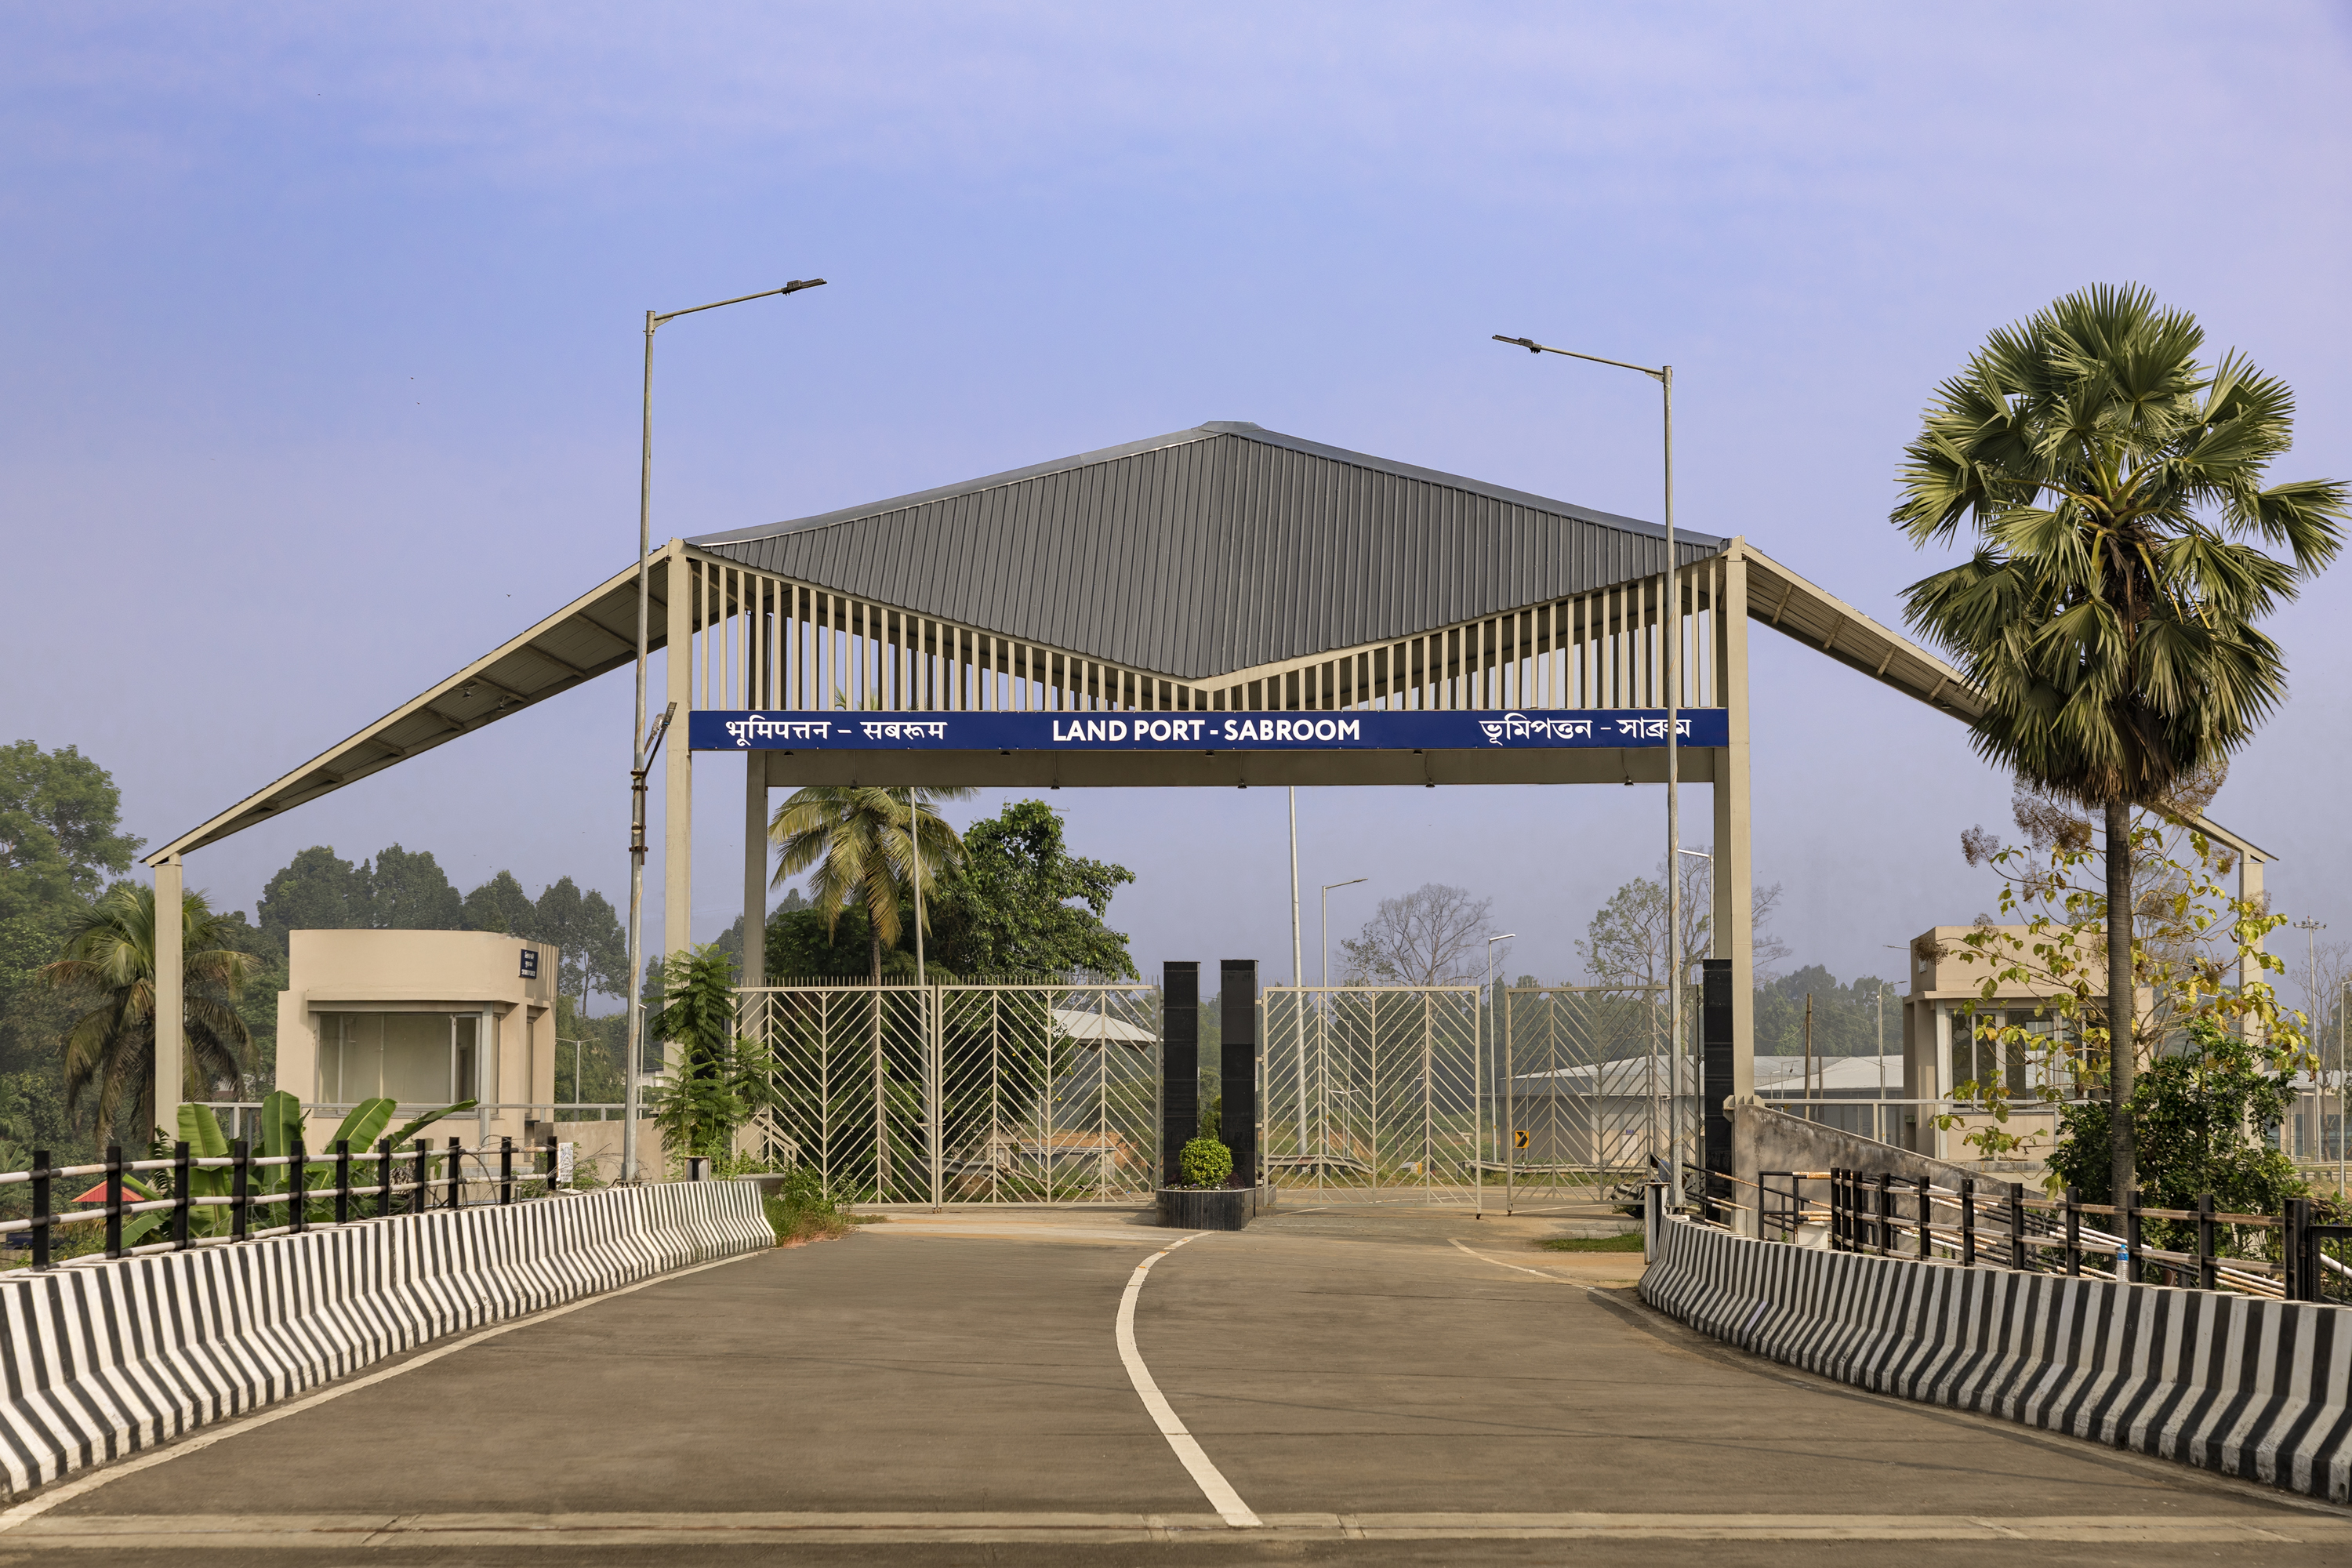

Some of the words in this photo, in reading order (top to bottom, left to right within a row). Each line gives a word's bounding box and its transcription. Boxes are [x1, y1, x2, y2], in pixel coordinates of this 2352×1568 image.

[725, 714, 833, 747] भूमिपत्तन
[859, 721, 949, 740] सबरूम
[1053, 720, 1127, 742] LAND
[1134, 720, 1206, 742] PORT
[1224, 719, 1360, 742] SABROOM
[1478, 712, 1593, 746] ভূমিপত্তন
